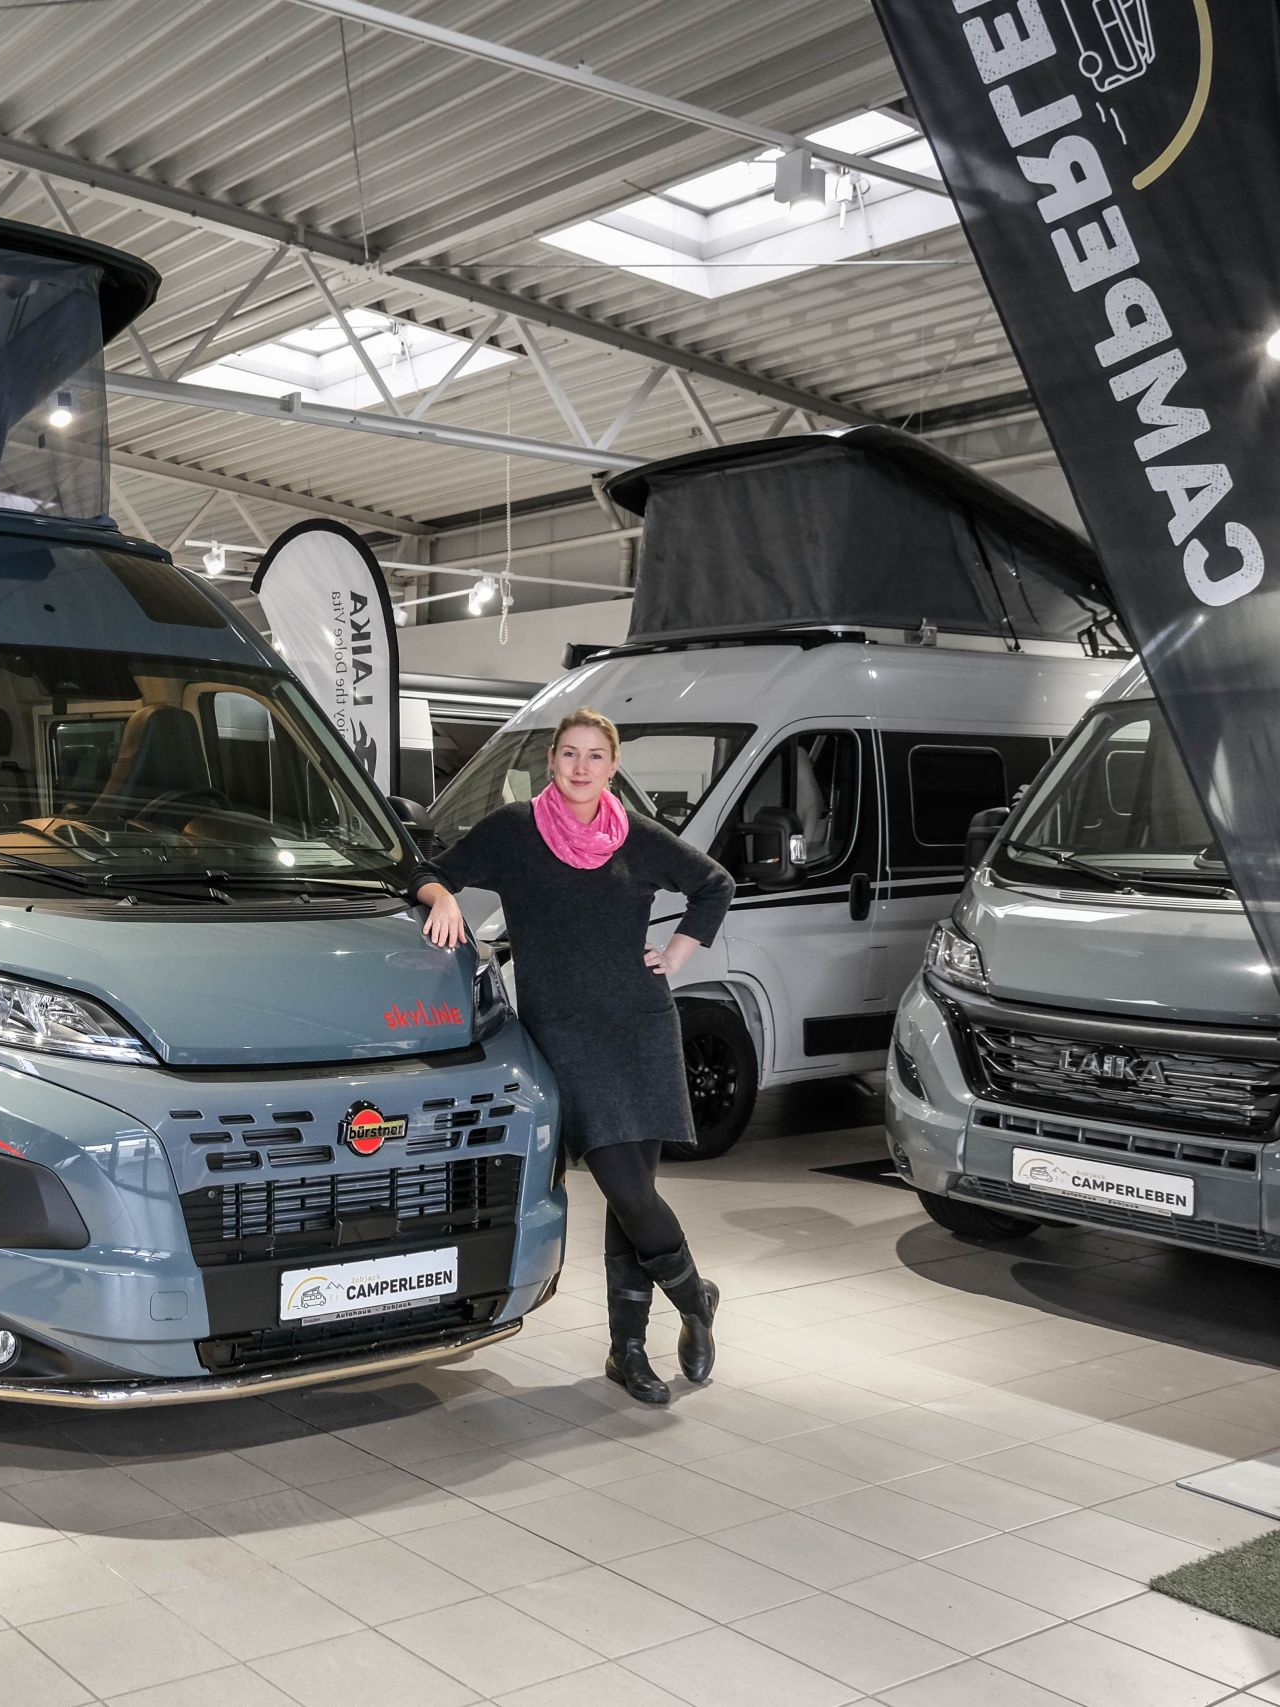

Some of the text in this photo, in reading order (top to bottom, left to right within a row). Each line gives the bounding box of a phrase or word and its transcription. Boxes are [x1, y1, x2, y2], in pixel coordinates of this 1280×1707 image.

[1060, 1050, 1166, 1084] LAIKA
[348, 1123, 404, 1140] bürstner
[1071, 1175, 1187, 1207] CAMPERLEBEN
[346, 1269, 453, 1301] CAMPERLEBEN
